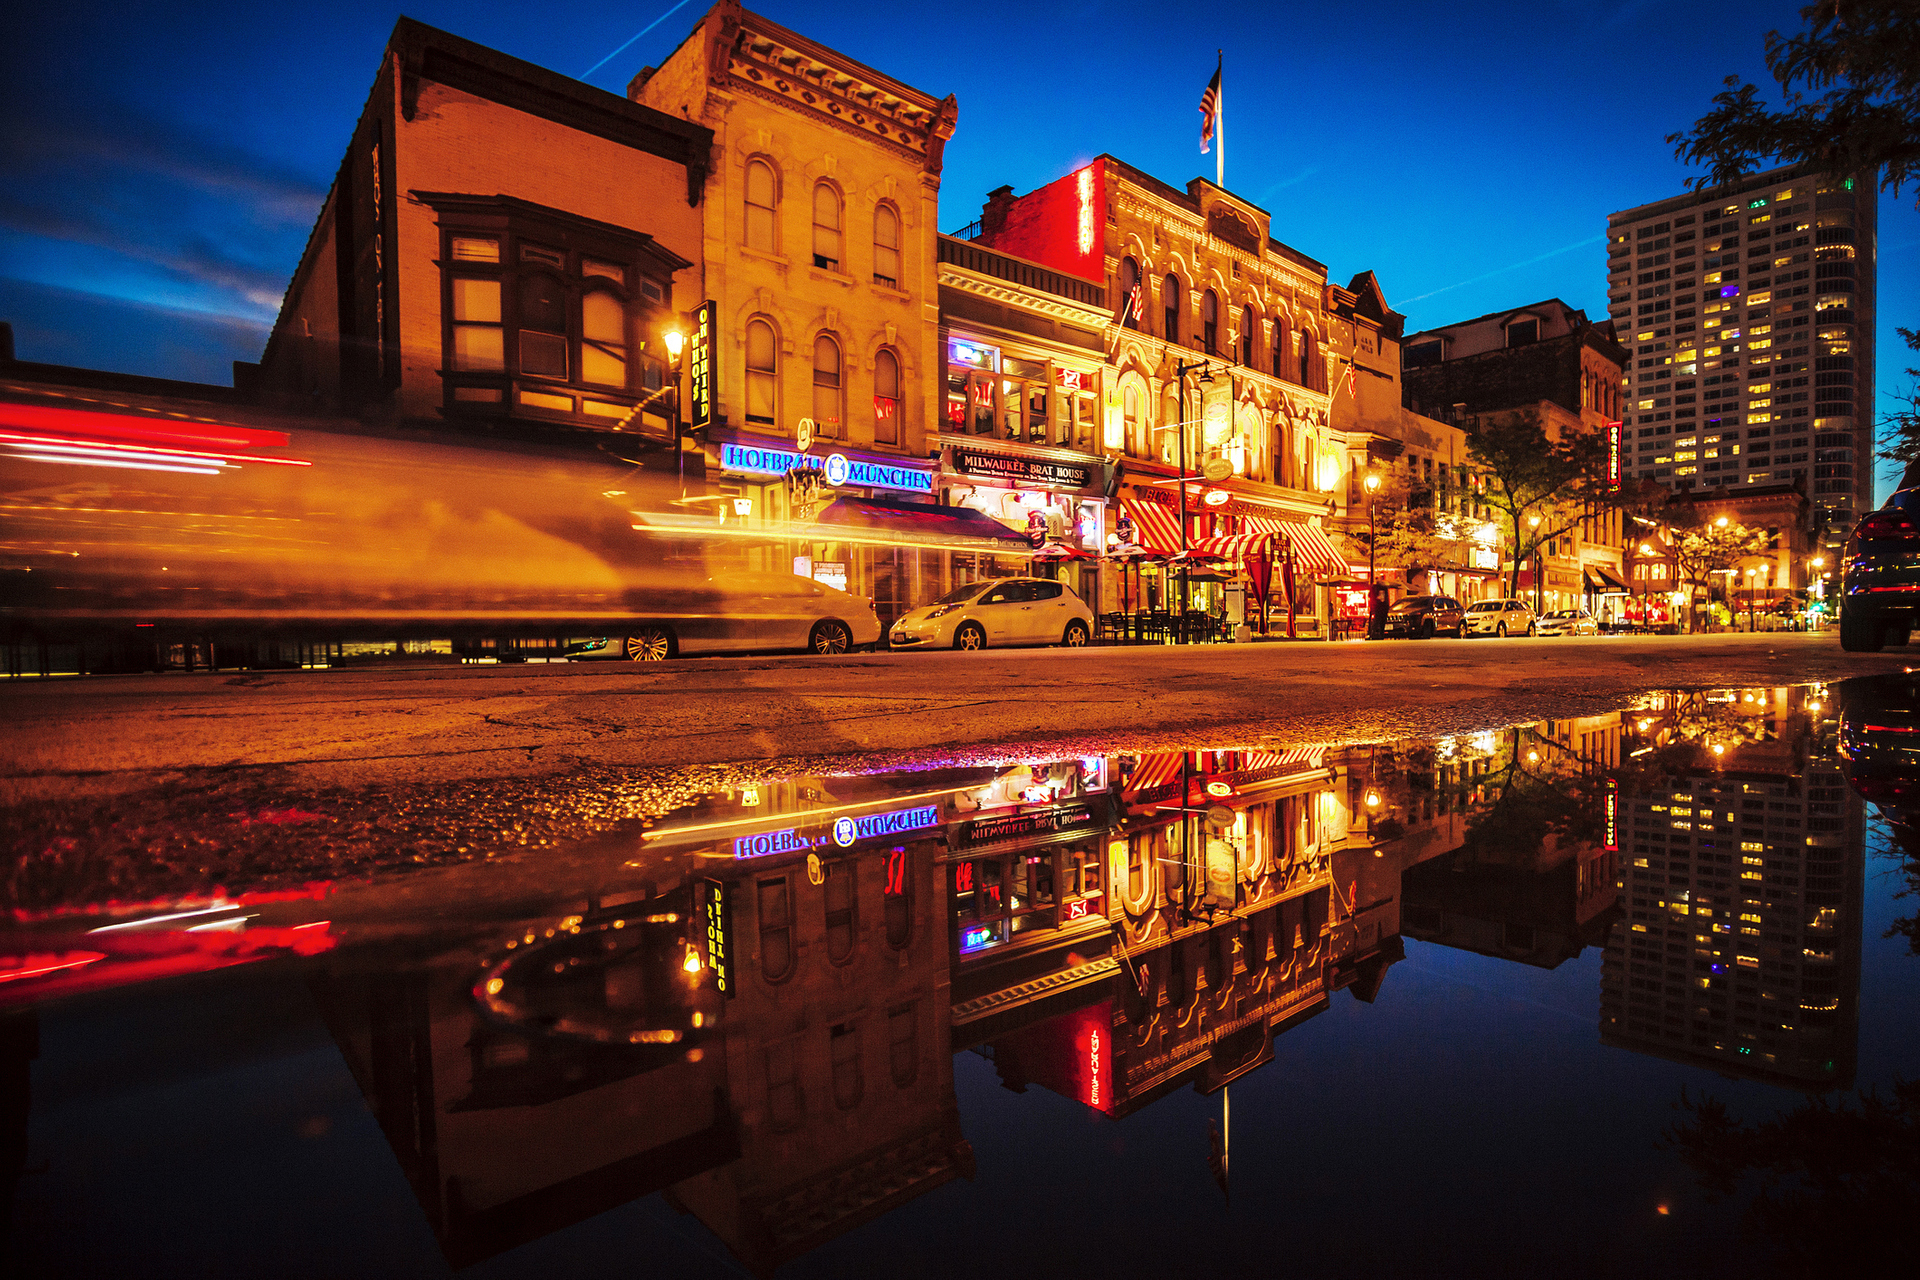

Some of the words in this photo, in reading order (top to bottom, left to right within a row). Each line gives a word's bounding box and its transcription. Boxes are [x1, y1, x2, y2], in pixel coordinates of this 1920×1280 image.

[699, 309, 708, 339] ON
[691, 332, 700, 402] WHO'S
[700, 343, 709, 417] THIRD
[964, 455, 1025, 472] MILWAUKEE
[1030, 463, 1053, 476] BRAT
[1056, 467, 1085, 480] HOUSE
